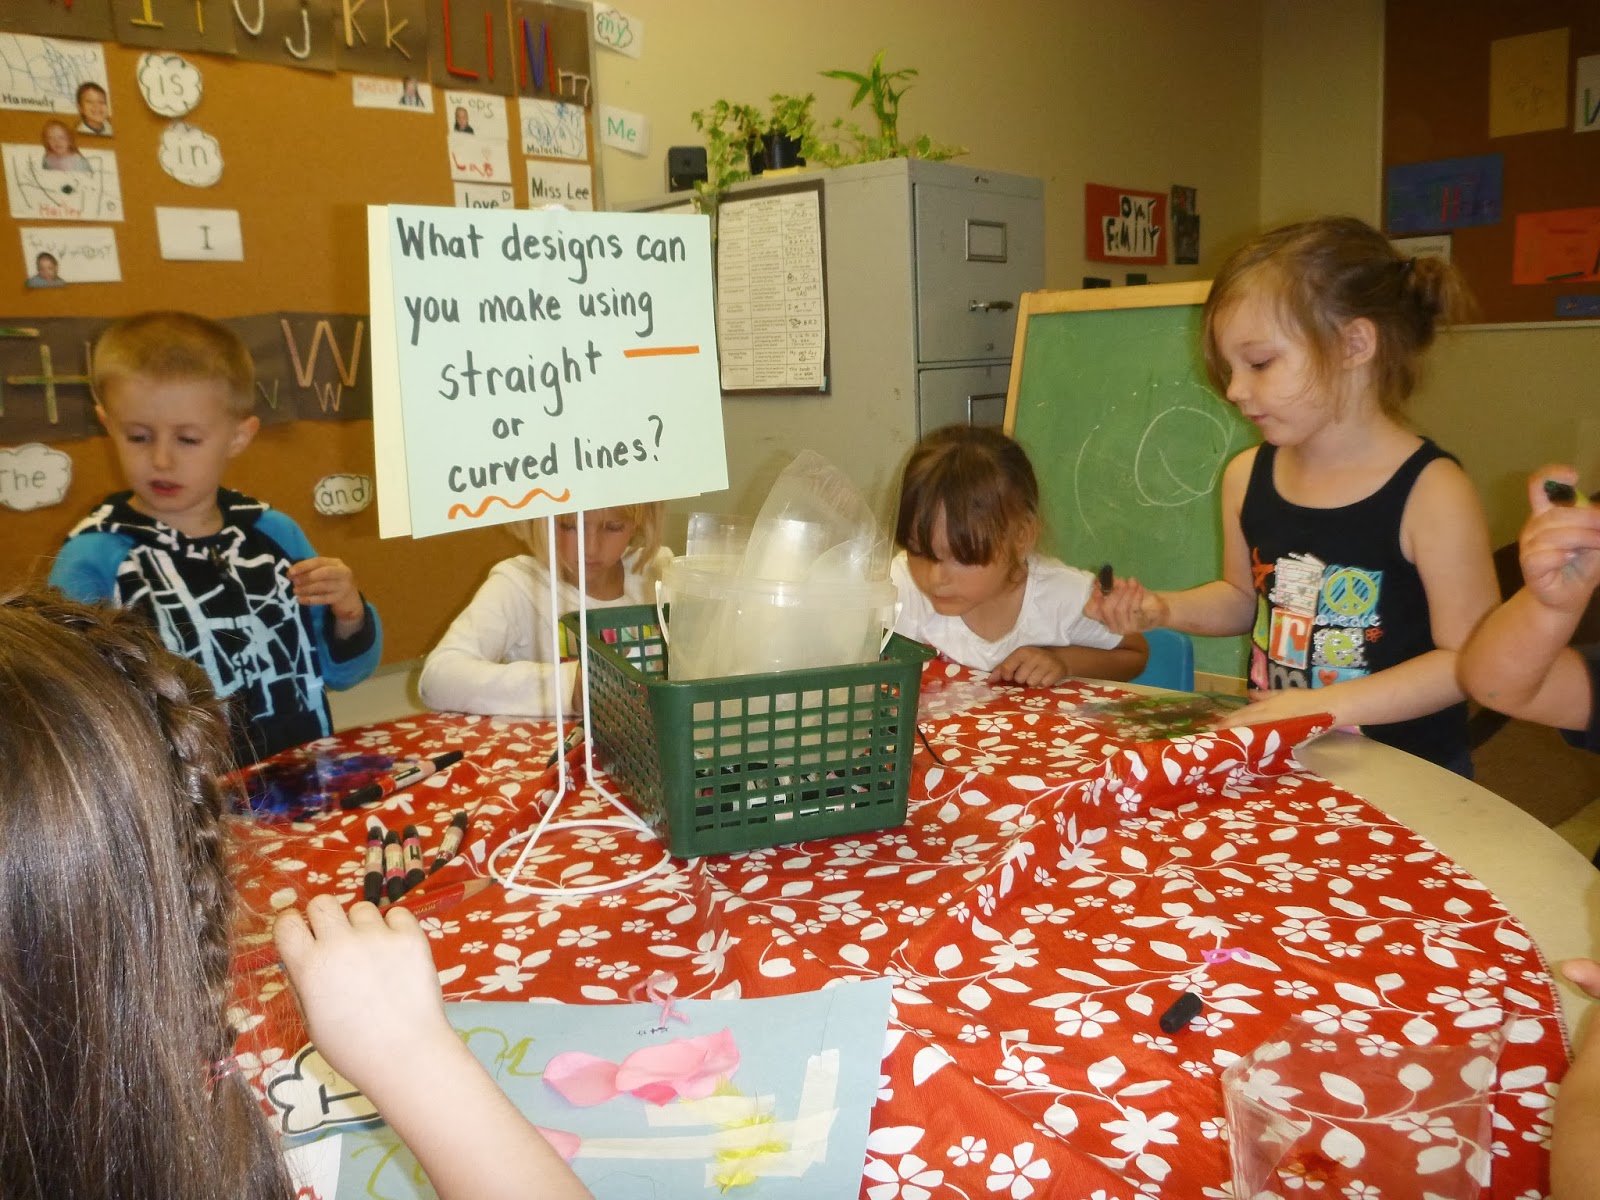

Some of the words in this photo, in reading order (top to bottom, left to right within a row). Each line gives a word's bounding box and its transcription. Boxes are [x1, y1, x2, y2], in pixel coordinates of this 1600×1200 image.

[158, 72, 185, 97] is
[607, 116, 638, 143] Me
[177, 138, 209, 168] in
[531, 177, 562, 200] Miss
[566, 182, 590, 201] Lee
[198, 225, 214, 251] I
[395, 216, 485, 262] What
[500, 221, 624, 285] designs
[636, 233, 687, 263] can
[403, 294, 461, 347] you
[478, 287, 562, 324] make
[578, 287, 655, 338] using
[438, 340, 603, 418] straight
[492, 417, 525, 440] or
[447, 441, 559, 493] curved
[573, 414, 664, 472] lines?
[321, 481, 366, 508] and
